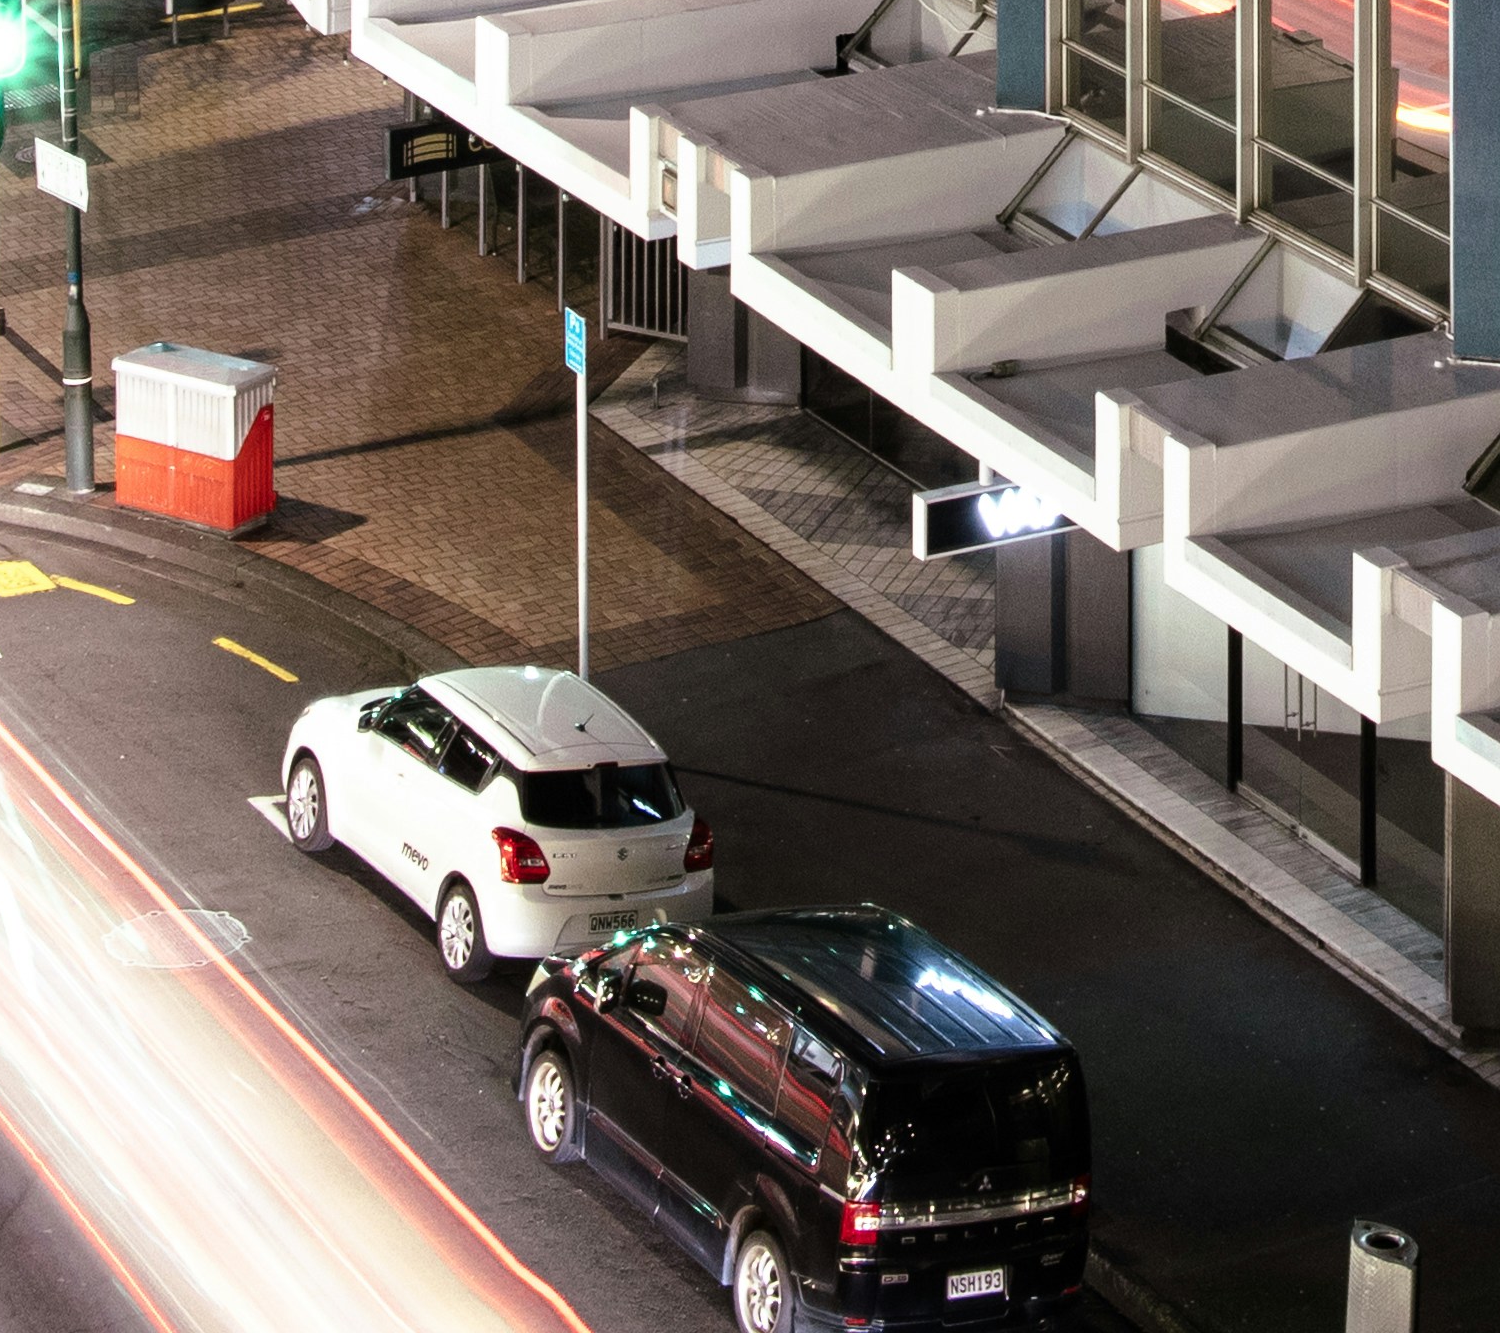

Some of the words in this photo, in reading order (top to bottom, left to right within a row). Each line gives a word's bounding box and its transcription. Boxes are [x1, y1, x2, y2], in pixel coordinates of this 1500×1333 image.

[401, 840, 429, 871] mevo
[590, 912, 636, 932] QNW566
[950, 1271, 1001, 1294] NSH193
